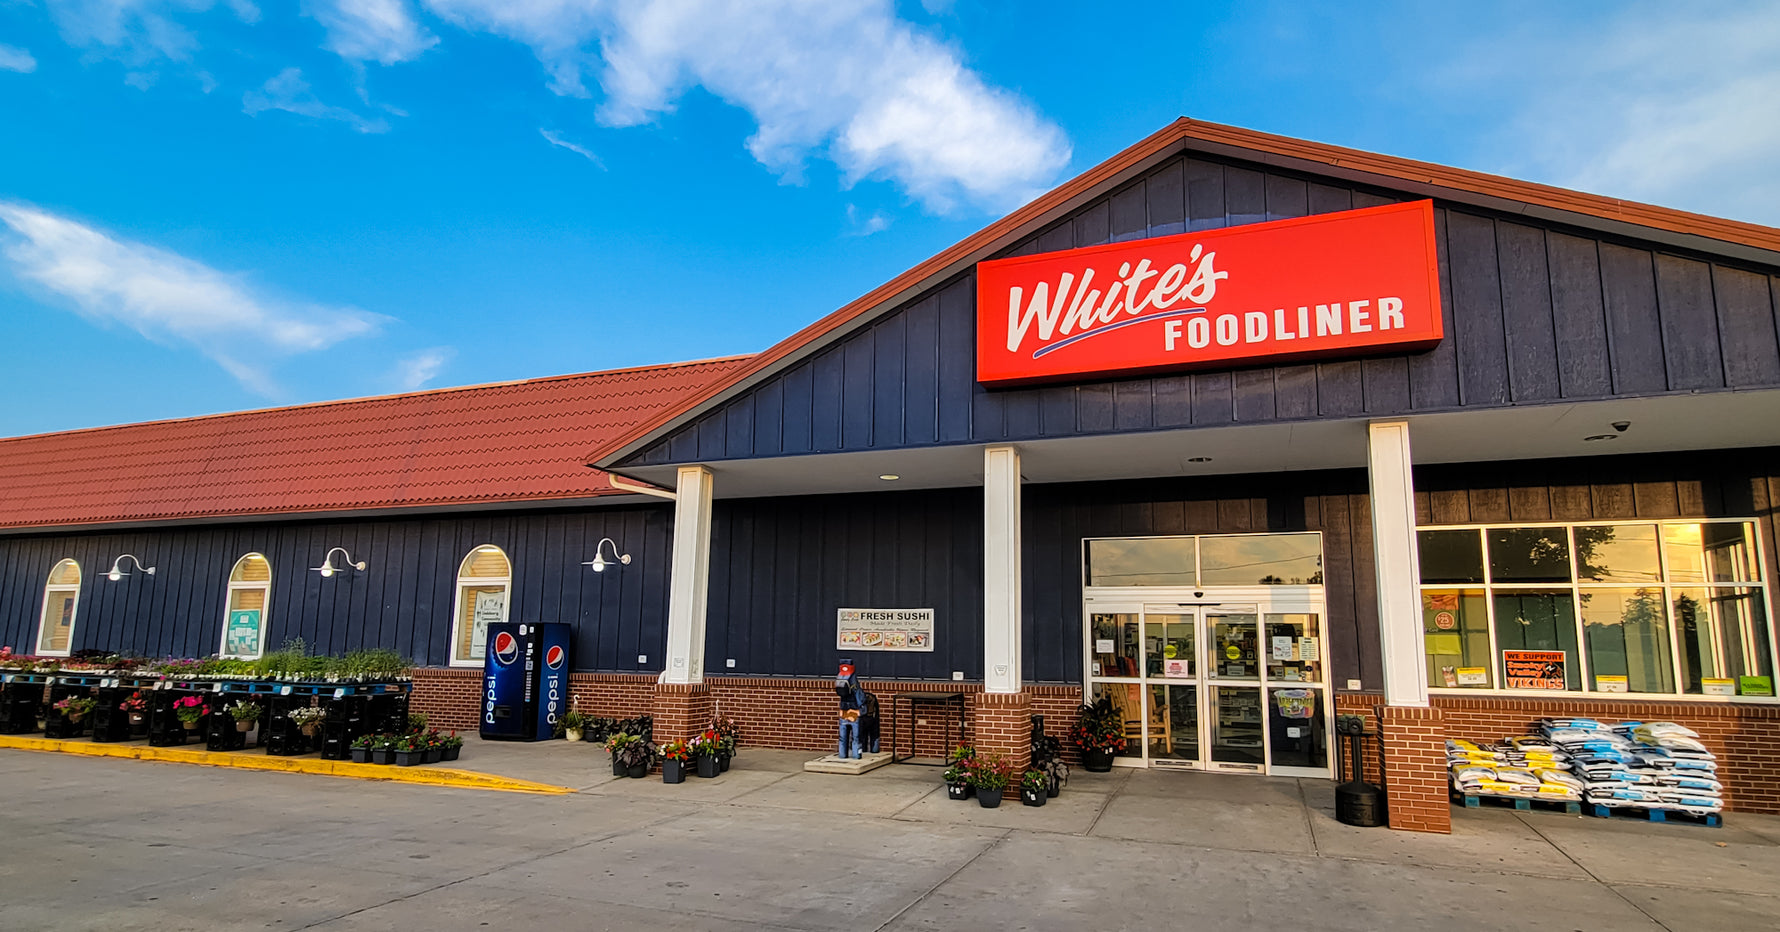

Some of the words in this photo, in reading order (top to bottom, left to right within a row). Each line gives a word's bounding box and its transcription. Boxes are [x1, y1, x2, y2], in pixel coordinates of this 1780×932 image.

[1006, 243, 1229, 353] White's
[1164, 296, 1406, 352] FOODLINER
[860, 612, 894, 621] FRESH
[897, 612, 930, 621] SUSHI
[1507, 668, 1544, 678] Valley
[1507, 677, 1564, 689] VIKINGS
[485, 675, 497, 724] pepsi
[546, 675, 560, 725] pepsi
